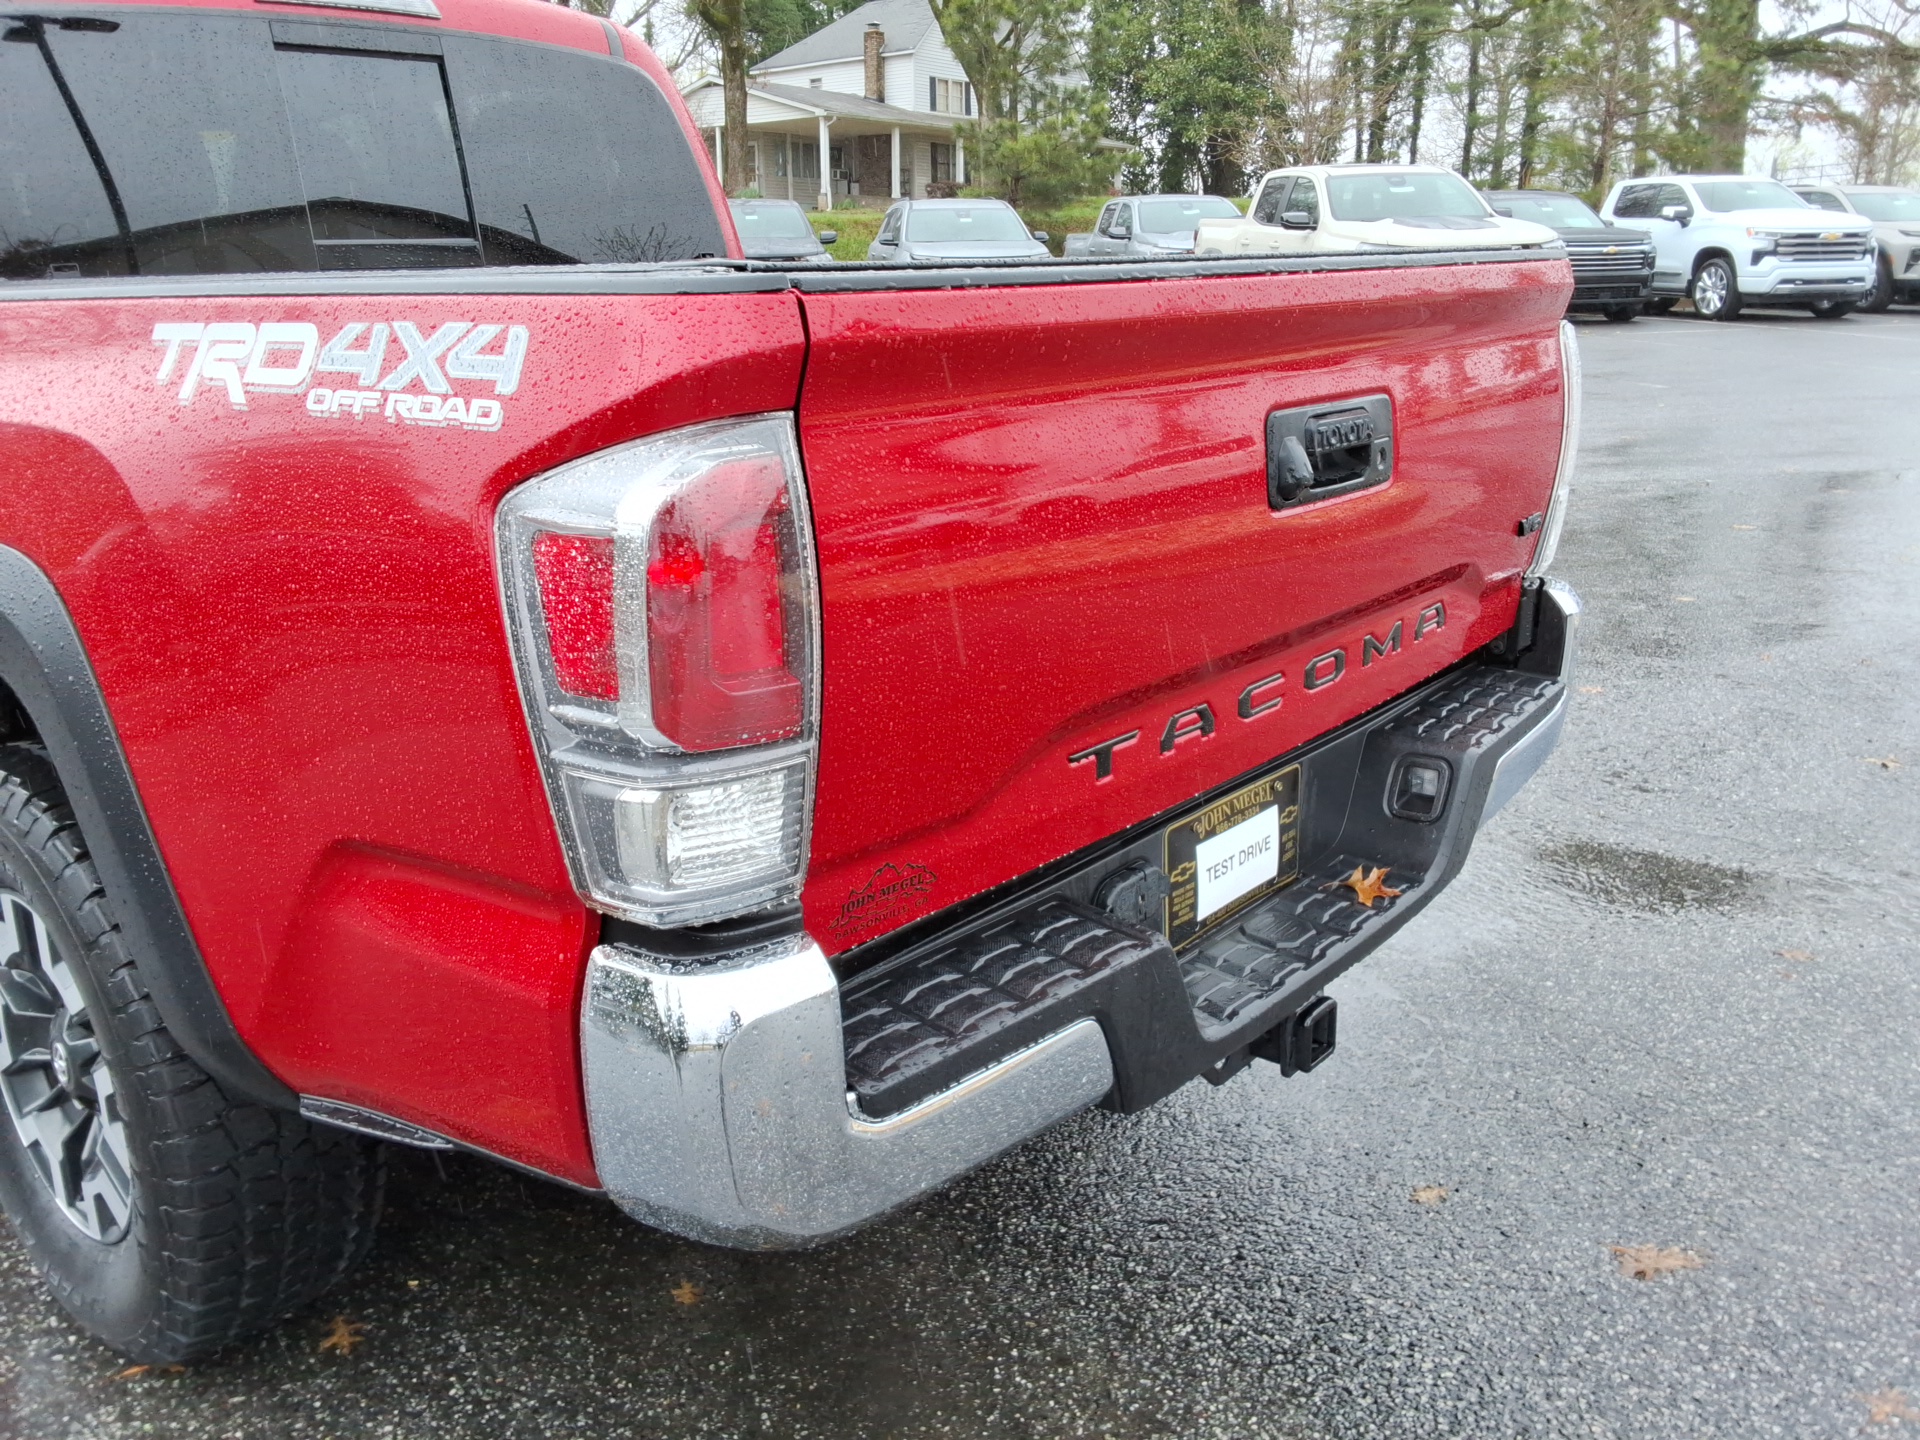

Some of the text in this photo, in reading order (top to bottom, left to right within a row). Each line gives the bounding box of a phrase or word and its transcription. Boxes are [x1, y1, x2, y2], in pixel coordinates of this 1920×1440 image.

[151, 322, 320, 411] TRD
[306, 388, 504, 432] OFF ROAD
[1068, 602, 1446, 784] TACOMA
[1199, 782, 1274, 839] JOHN MEGEL
[1206, 854, 1235, 883] TEST
[1239, 835, 1271, 867] DRIVE
[841, 872, 925, 920] JOHN MEGEL
